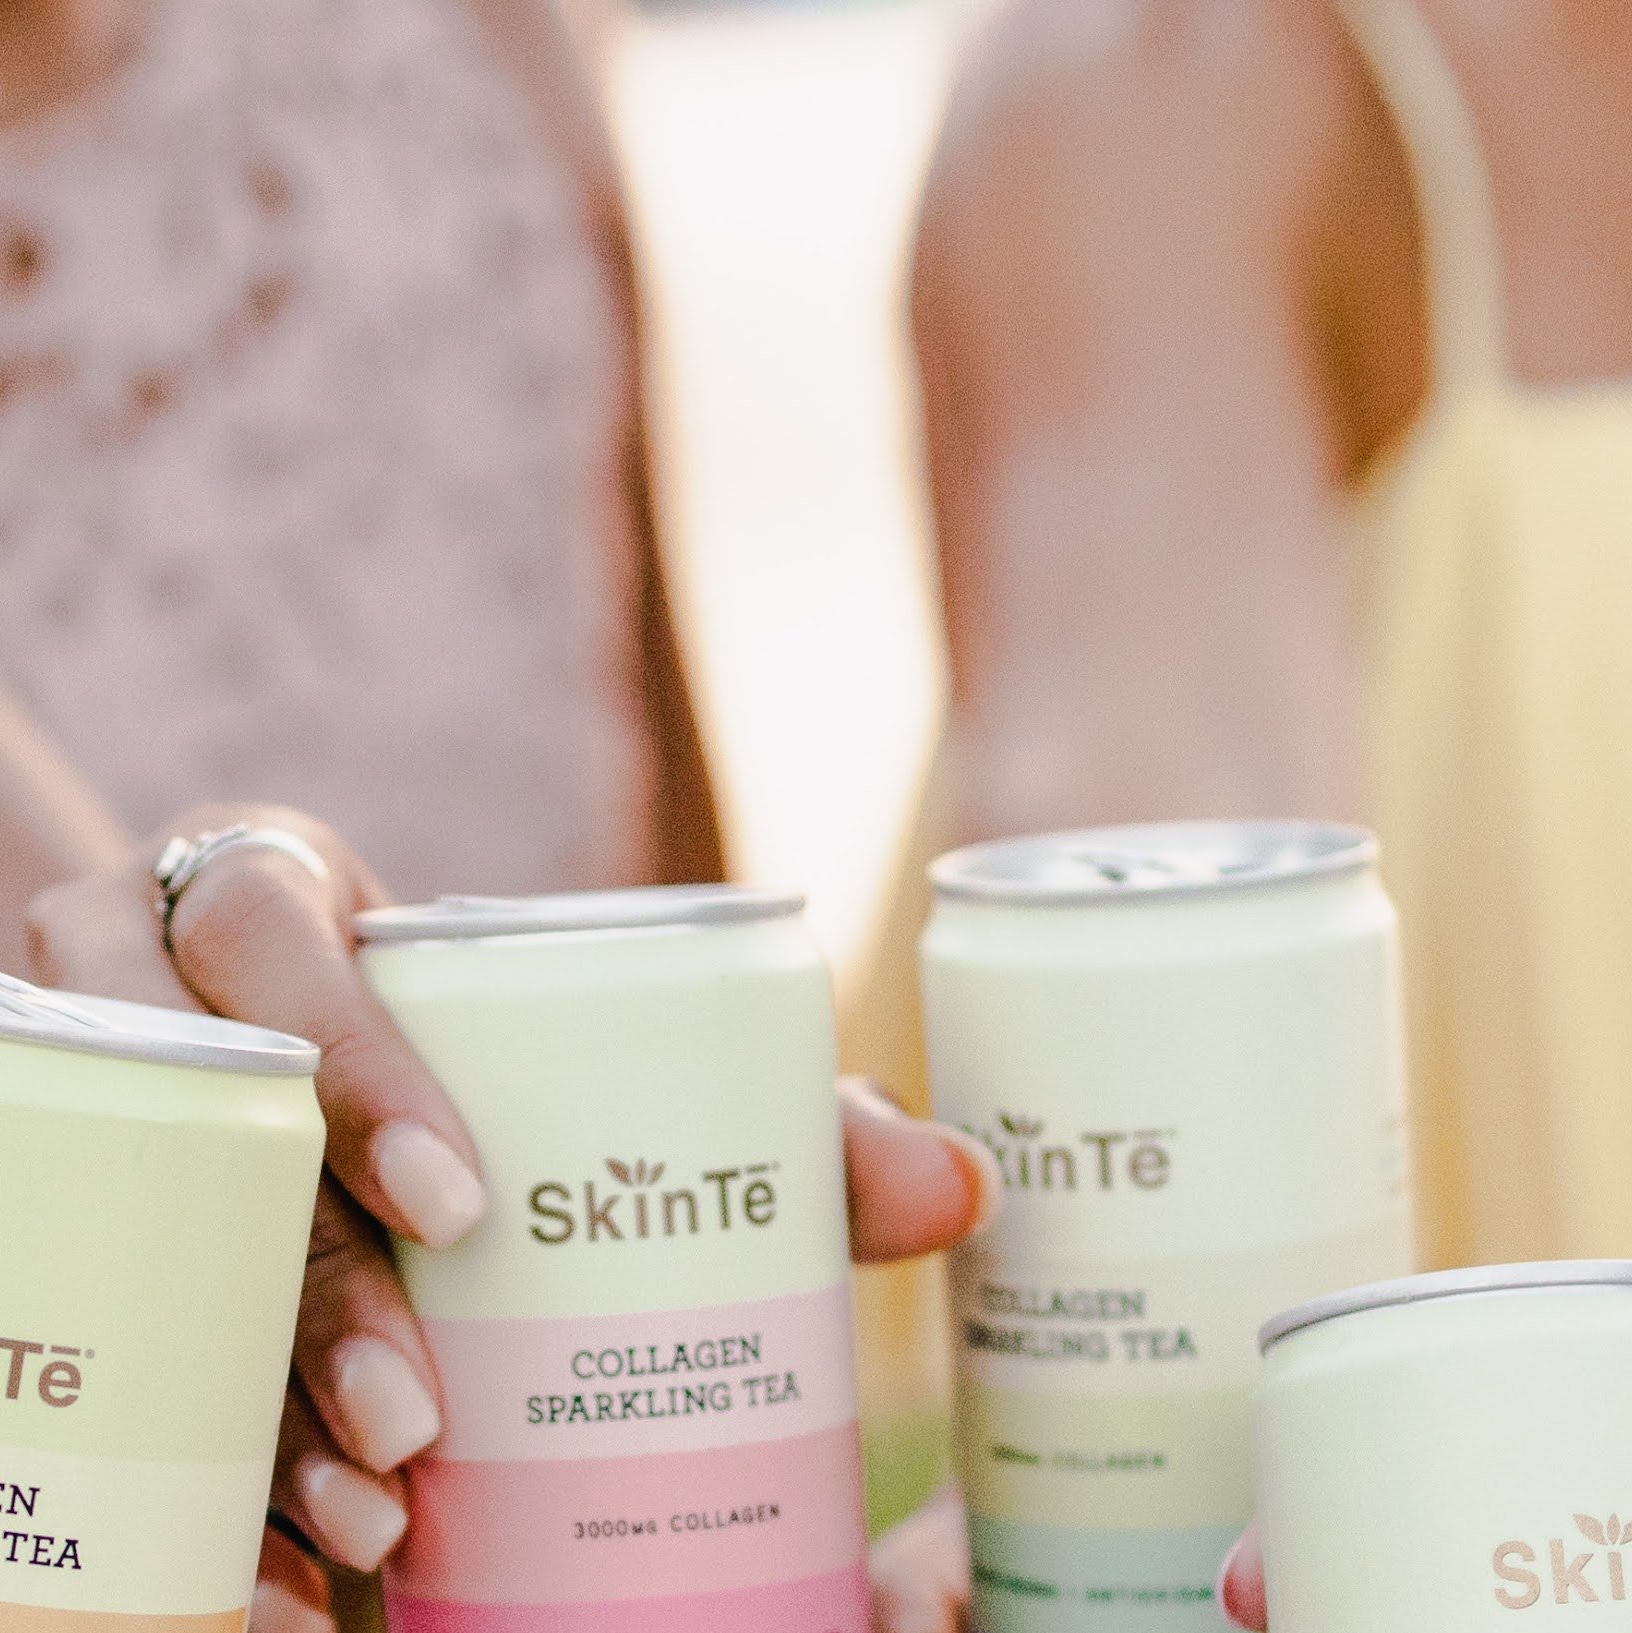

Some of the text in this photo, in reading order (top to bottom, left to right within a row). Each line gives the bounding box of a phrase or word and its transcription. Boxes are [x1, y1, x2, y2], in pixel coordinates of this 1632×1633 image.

[571, 1333, 761, 1380] COLLAGEN
[1121, 1328, 1199, 1362] TEA
[526, 1370, 801, 1424] SPARKLING TEA
[669, 1504, 781, 1534] COLLAGEN
[3, 1531, 82, 1569] TEA
